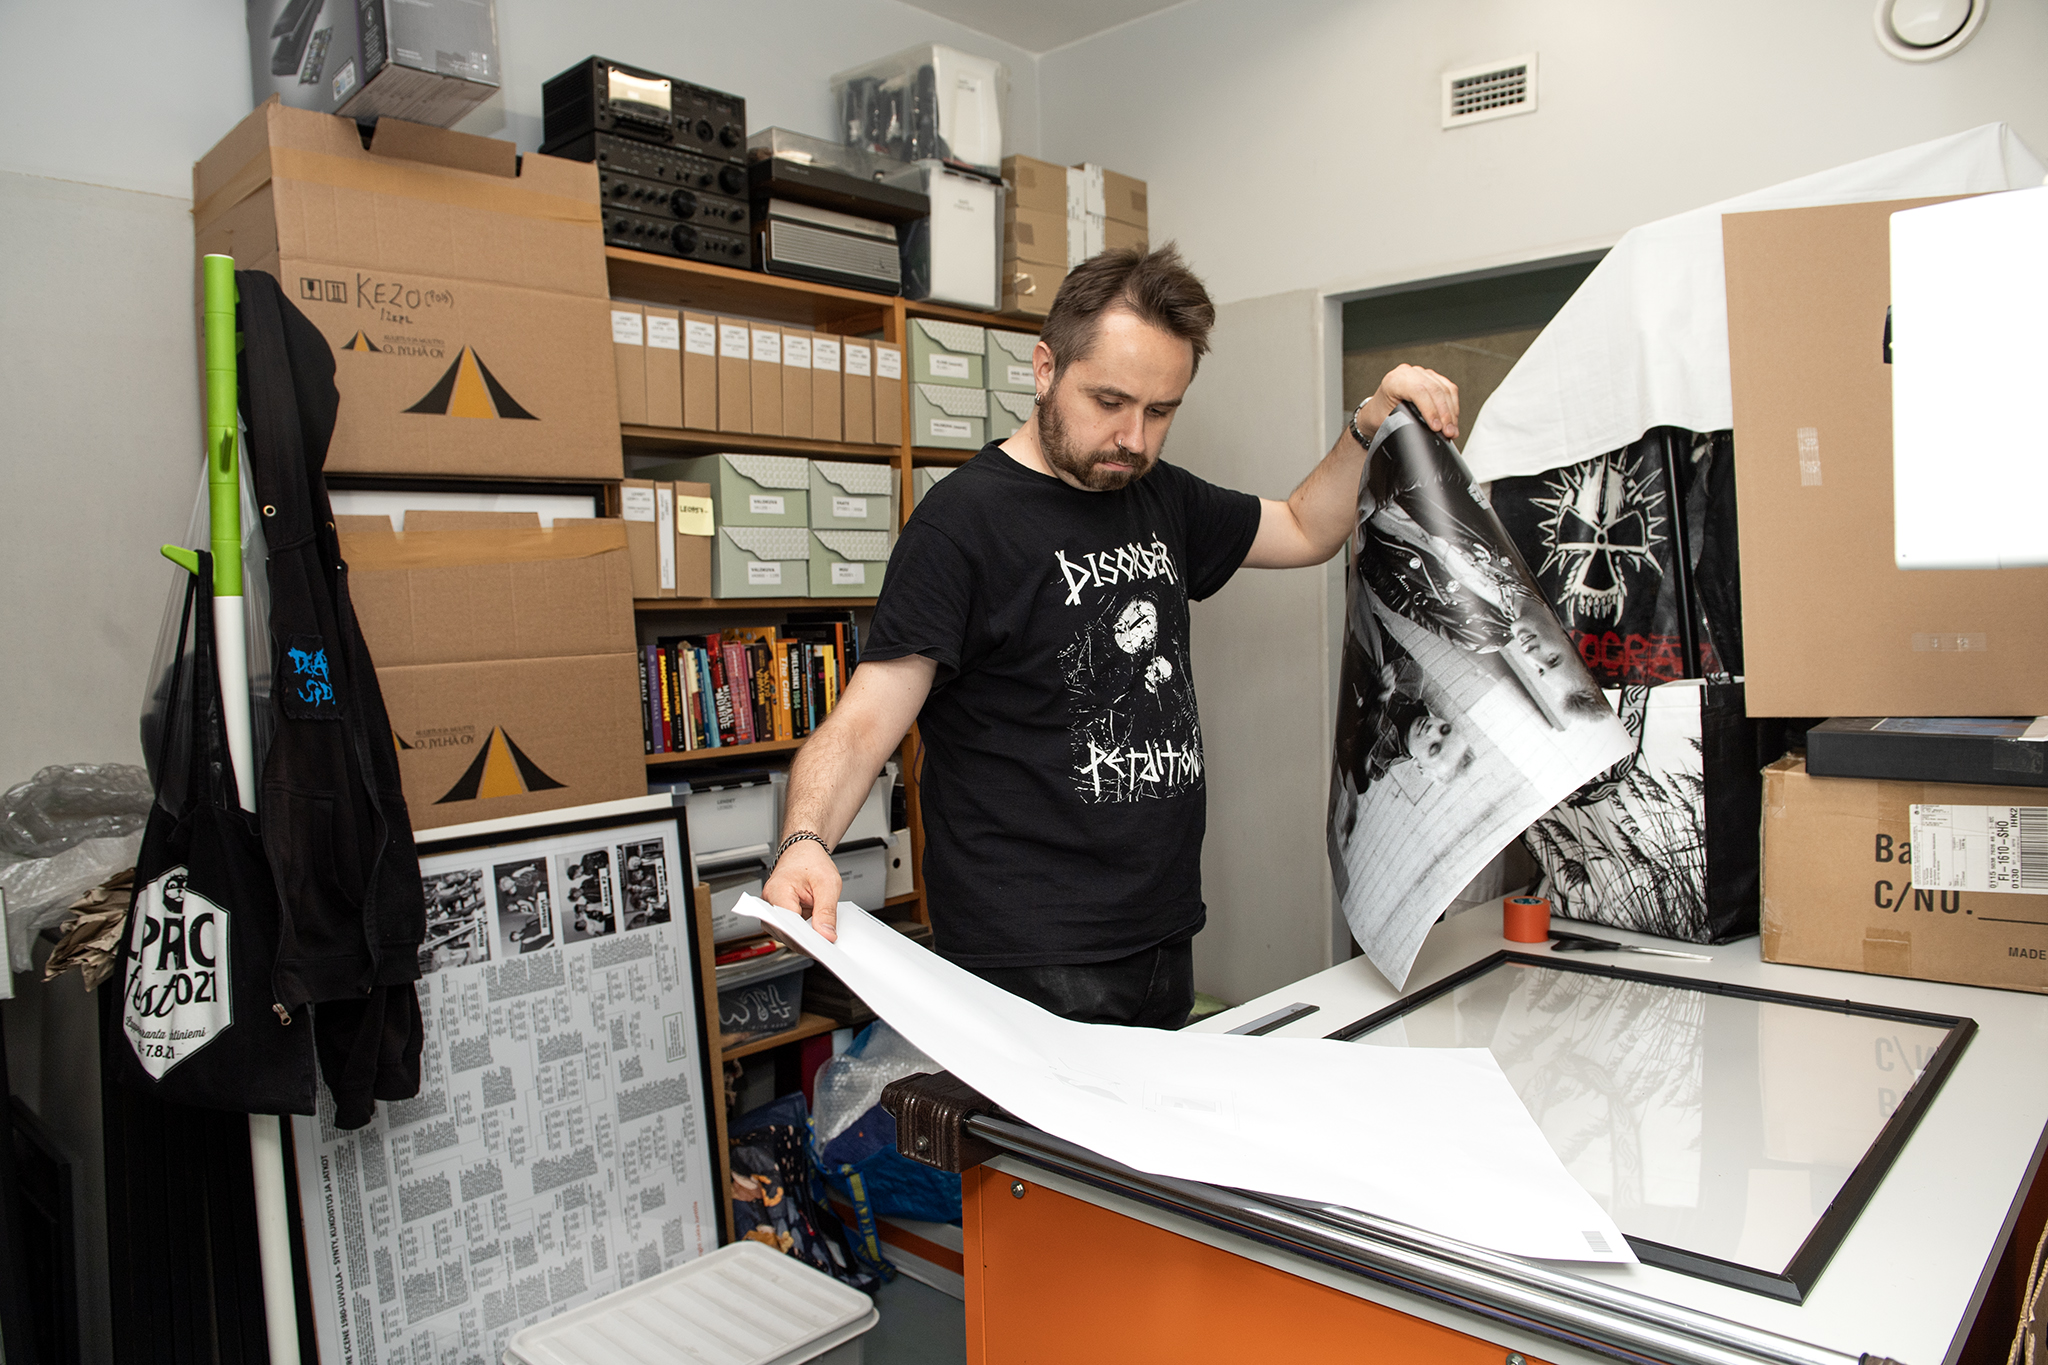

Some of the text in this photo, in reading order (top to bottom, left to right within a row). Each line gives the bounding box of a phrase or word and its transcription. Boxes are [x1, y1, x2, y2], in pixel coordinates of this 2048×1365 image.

[356, 272, 421, 310] KEZO
[1055, 533, 1177, 606] DISORDER
[671, 671, 681, 716] SUOMIPUNK
[780, 656, 791, 710] The Clash
[793, 689, 801, 709] 1984
[714, 692, 730, 730] MONROE
[722, 684, 735, 729] MICHAEL
[2010, 807, 2019, 828] IHK2
[1989, 871, 1997, 889] 0115
[2011, 868, 2020, 889] 0130
[2008, 946, 2048, 961] MADE
[320, 1154, 332, 1183] JATKOT
[324, 1182, 333, 1192] JA
[325, 1192, 338, 1238] KUKOISTUS
[335, 1273, 349, 1328] 1980-LUVULLA
[341, 1329, 352, 1354] SCENE
